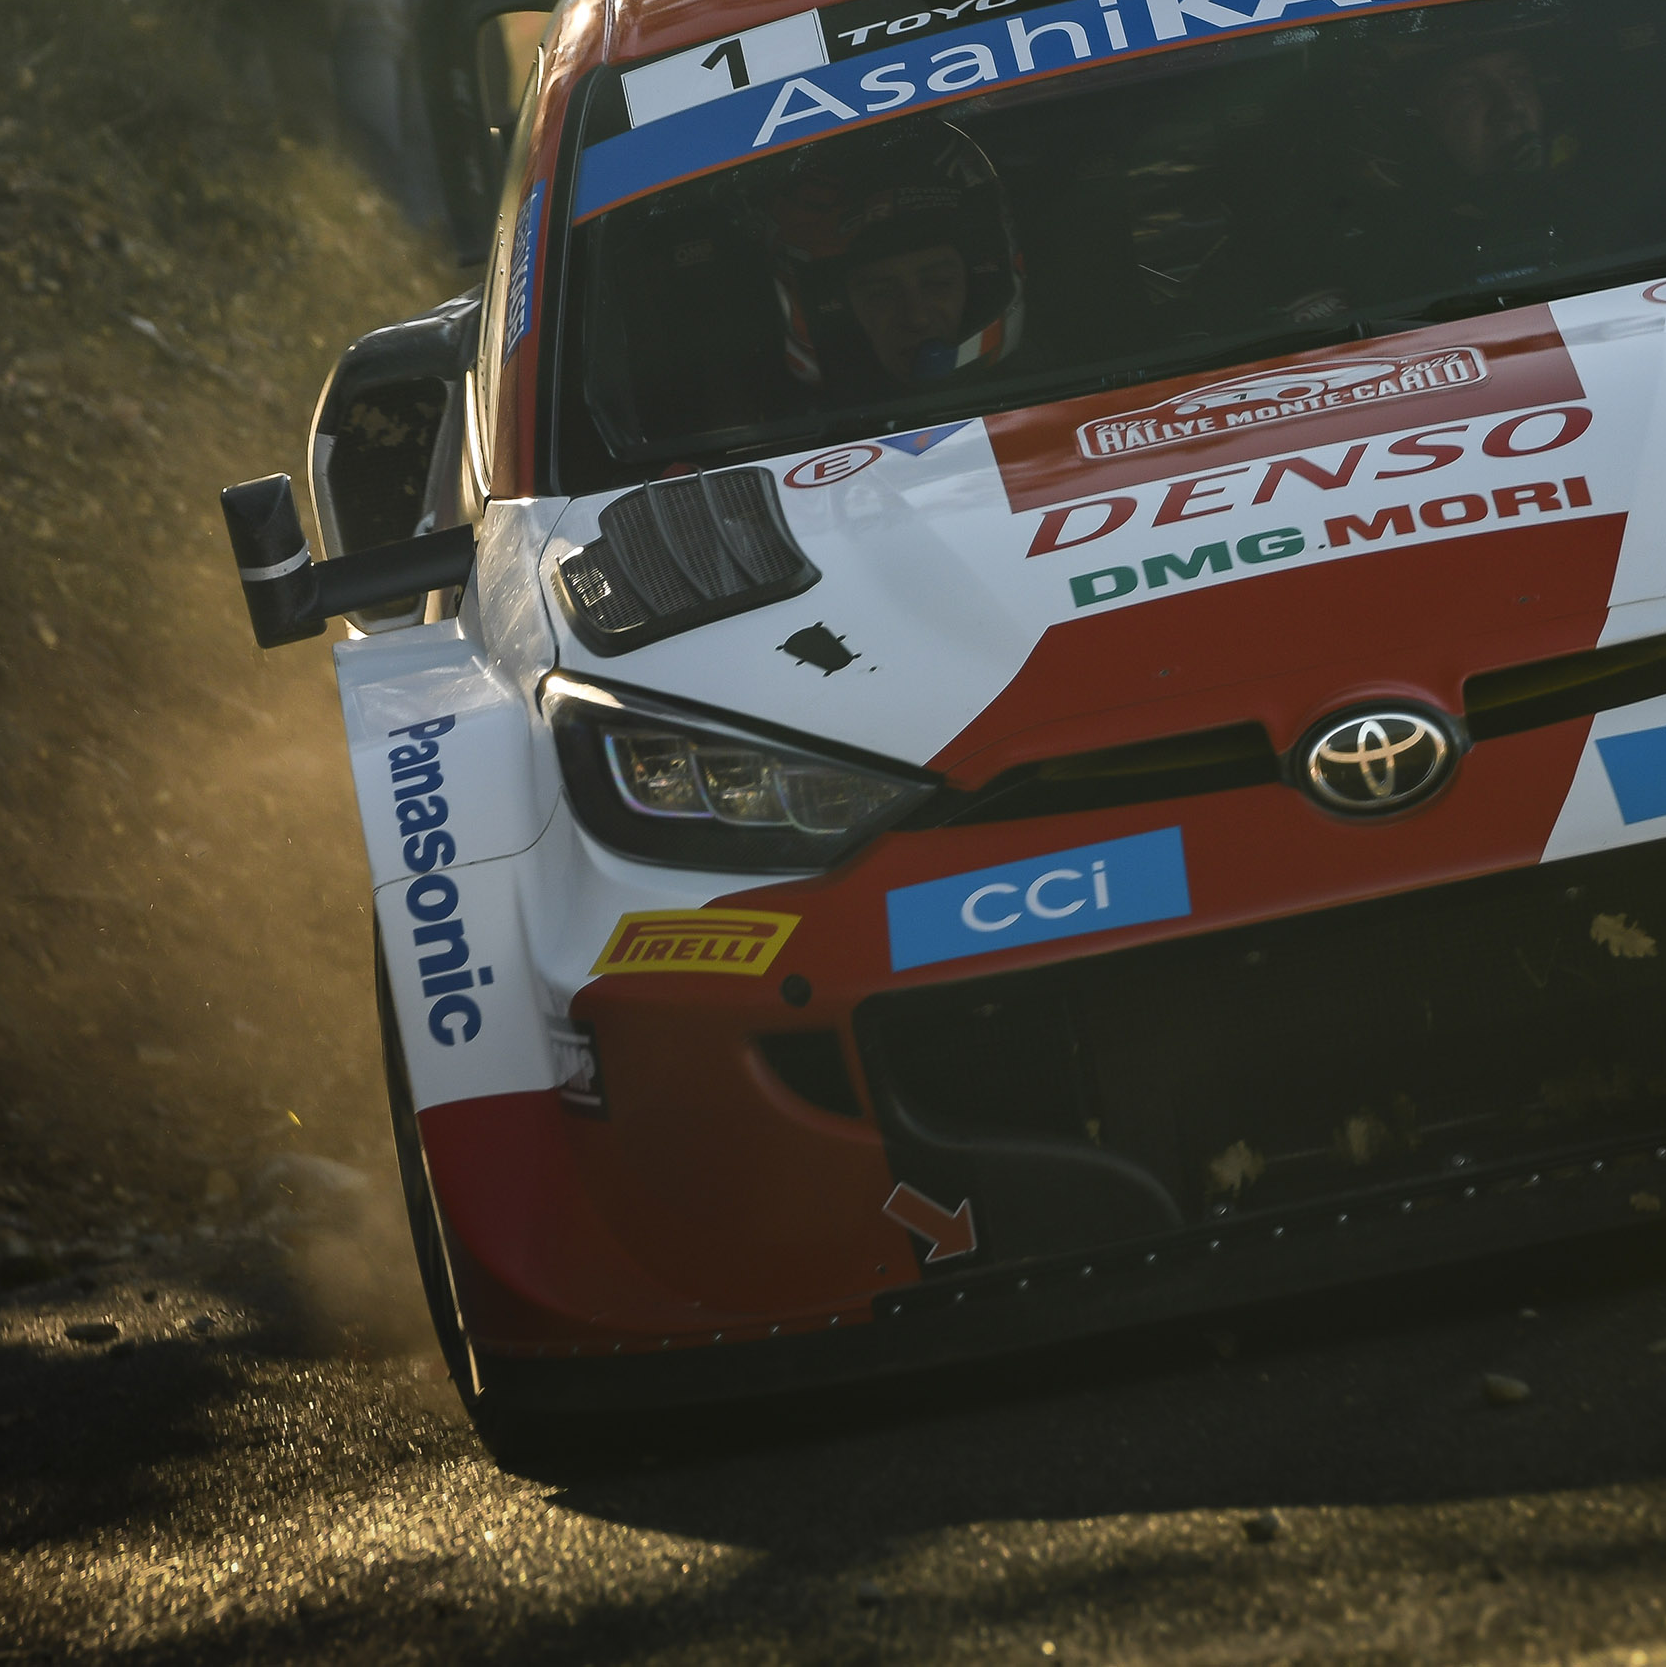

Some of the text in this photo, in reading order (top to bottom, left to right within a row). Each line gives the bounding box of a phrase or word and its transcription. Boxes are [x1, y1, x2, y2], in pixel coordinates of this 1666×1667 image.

[700, 37, 751, 91] 1
[1099, 359, 1470, 456] RALLYE MONTE-CARLO
[1399, 351, 1462, 376] 2022
[1025, 406, 1594, 559] DENSO
[1068, 475, 1594, 609] DMG MORI
[387, 713, 495, 1047] Panasonic
[605, 917, 780, 965] PIRELLI
